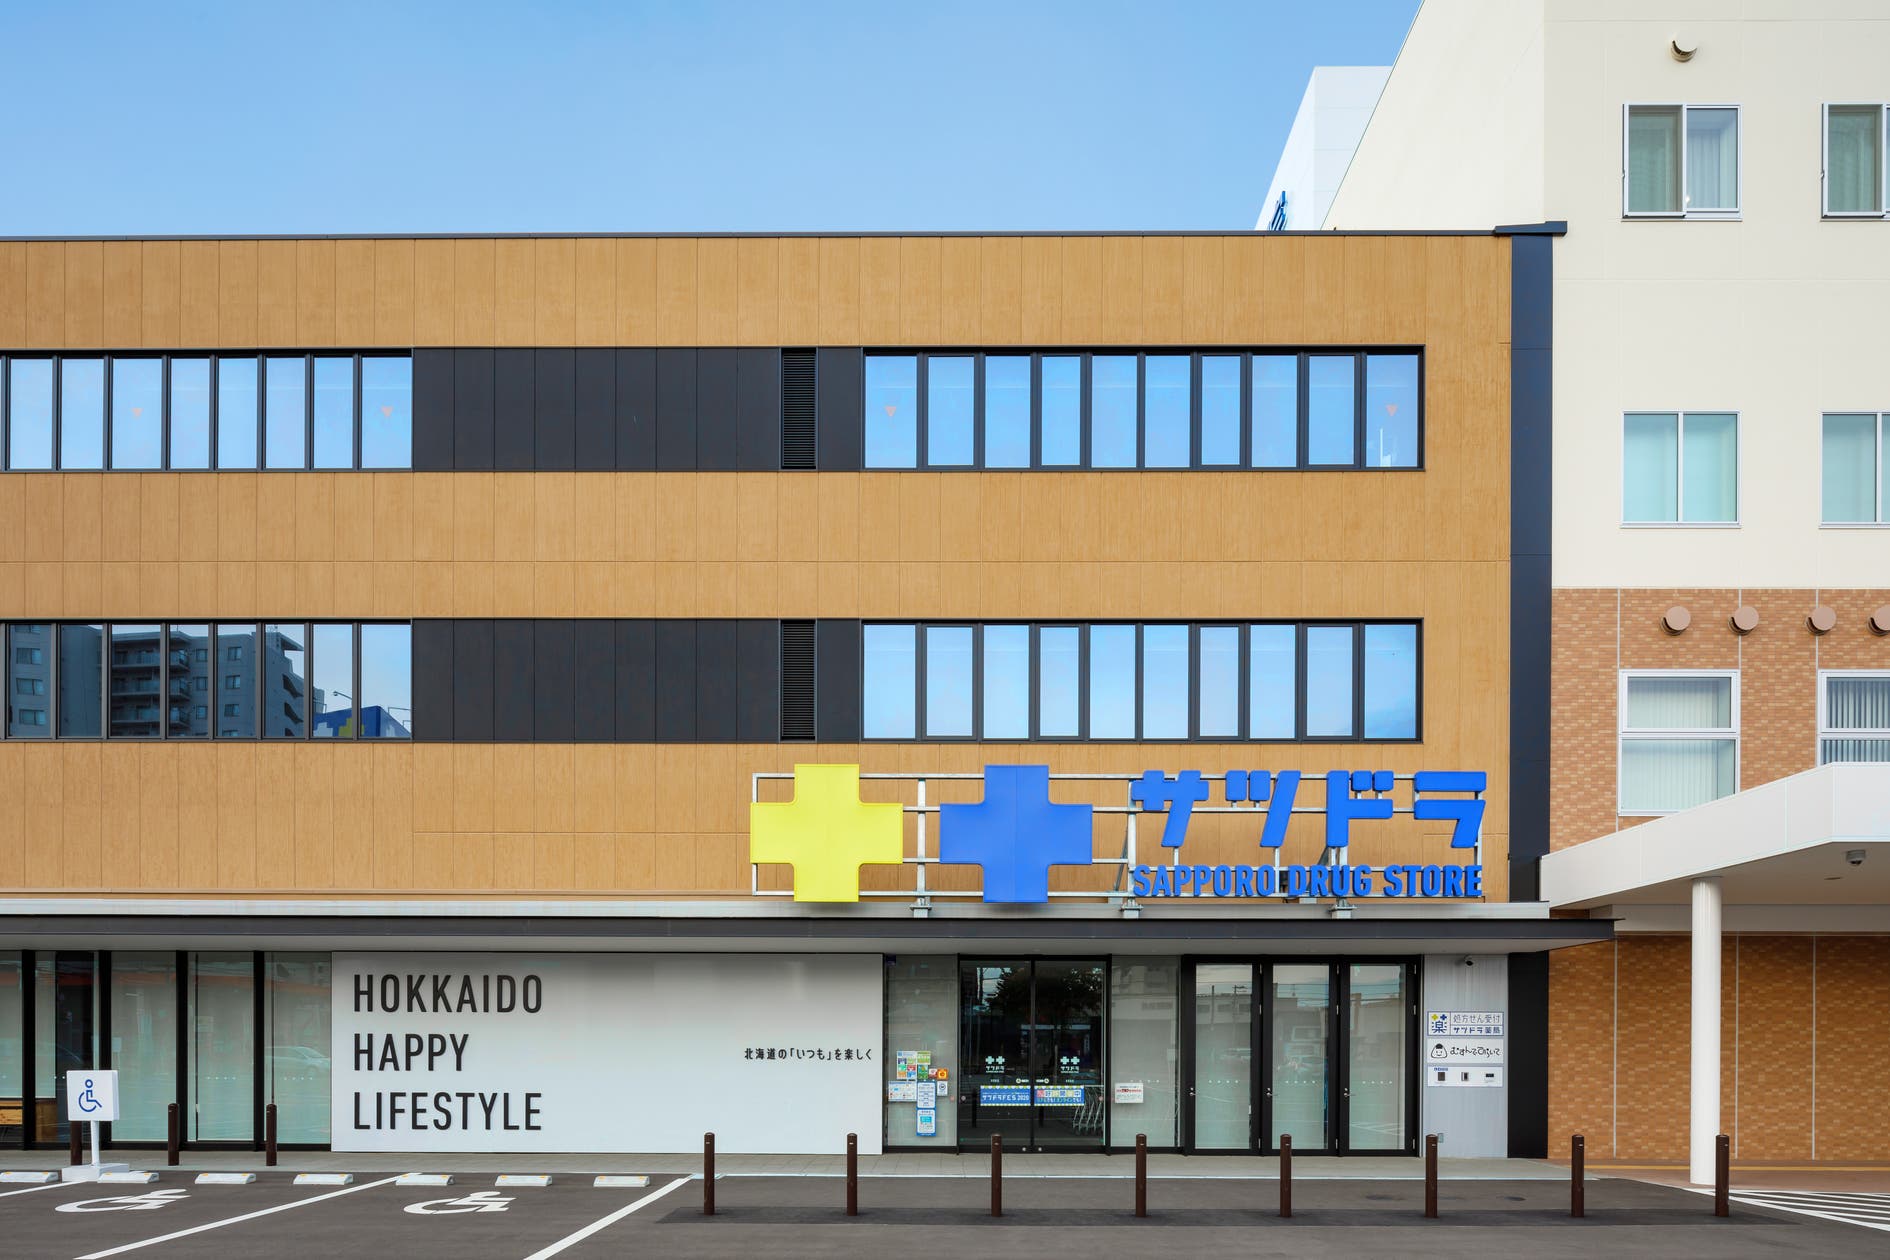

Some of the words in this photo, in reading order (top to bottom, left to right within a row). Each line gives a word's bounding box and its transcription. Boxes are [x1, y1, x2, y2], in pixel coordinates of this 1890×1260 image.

[1131, 770, 1487, 848] サツドラ
[1133, 864, 1276, 896] SAPPORO
[1287, 864, 1372, 897] DRUG
[1383, 864, 1483, 897] STORE
[354, 974, 543, 1014] HOKKAIDO
[1453, 1014, 1500, 1024] 処方せん受付
[354, 1033, 469, 1072] HAPPY
[744, 1047, 872, 1061] 北海道の「いつも」を楽しく
[354, 1092, 542, 1131] LIFESTYLE
